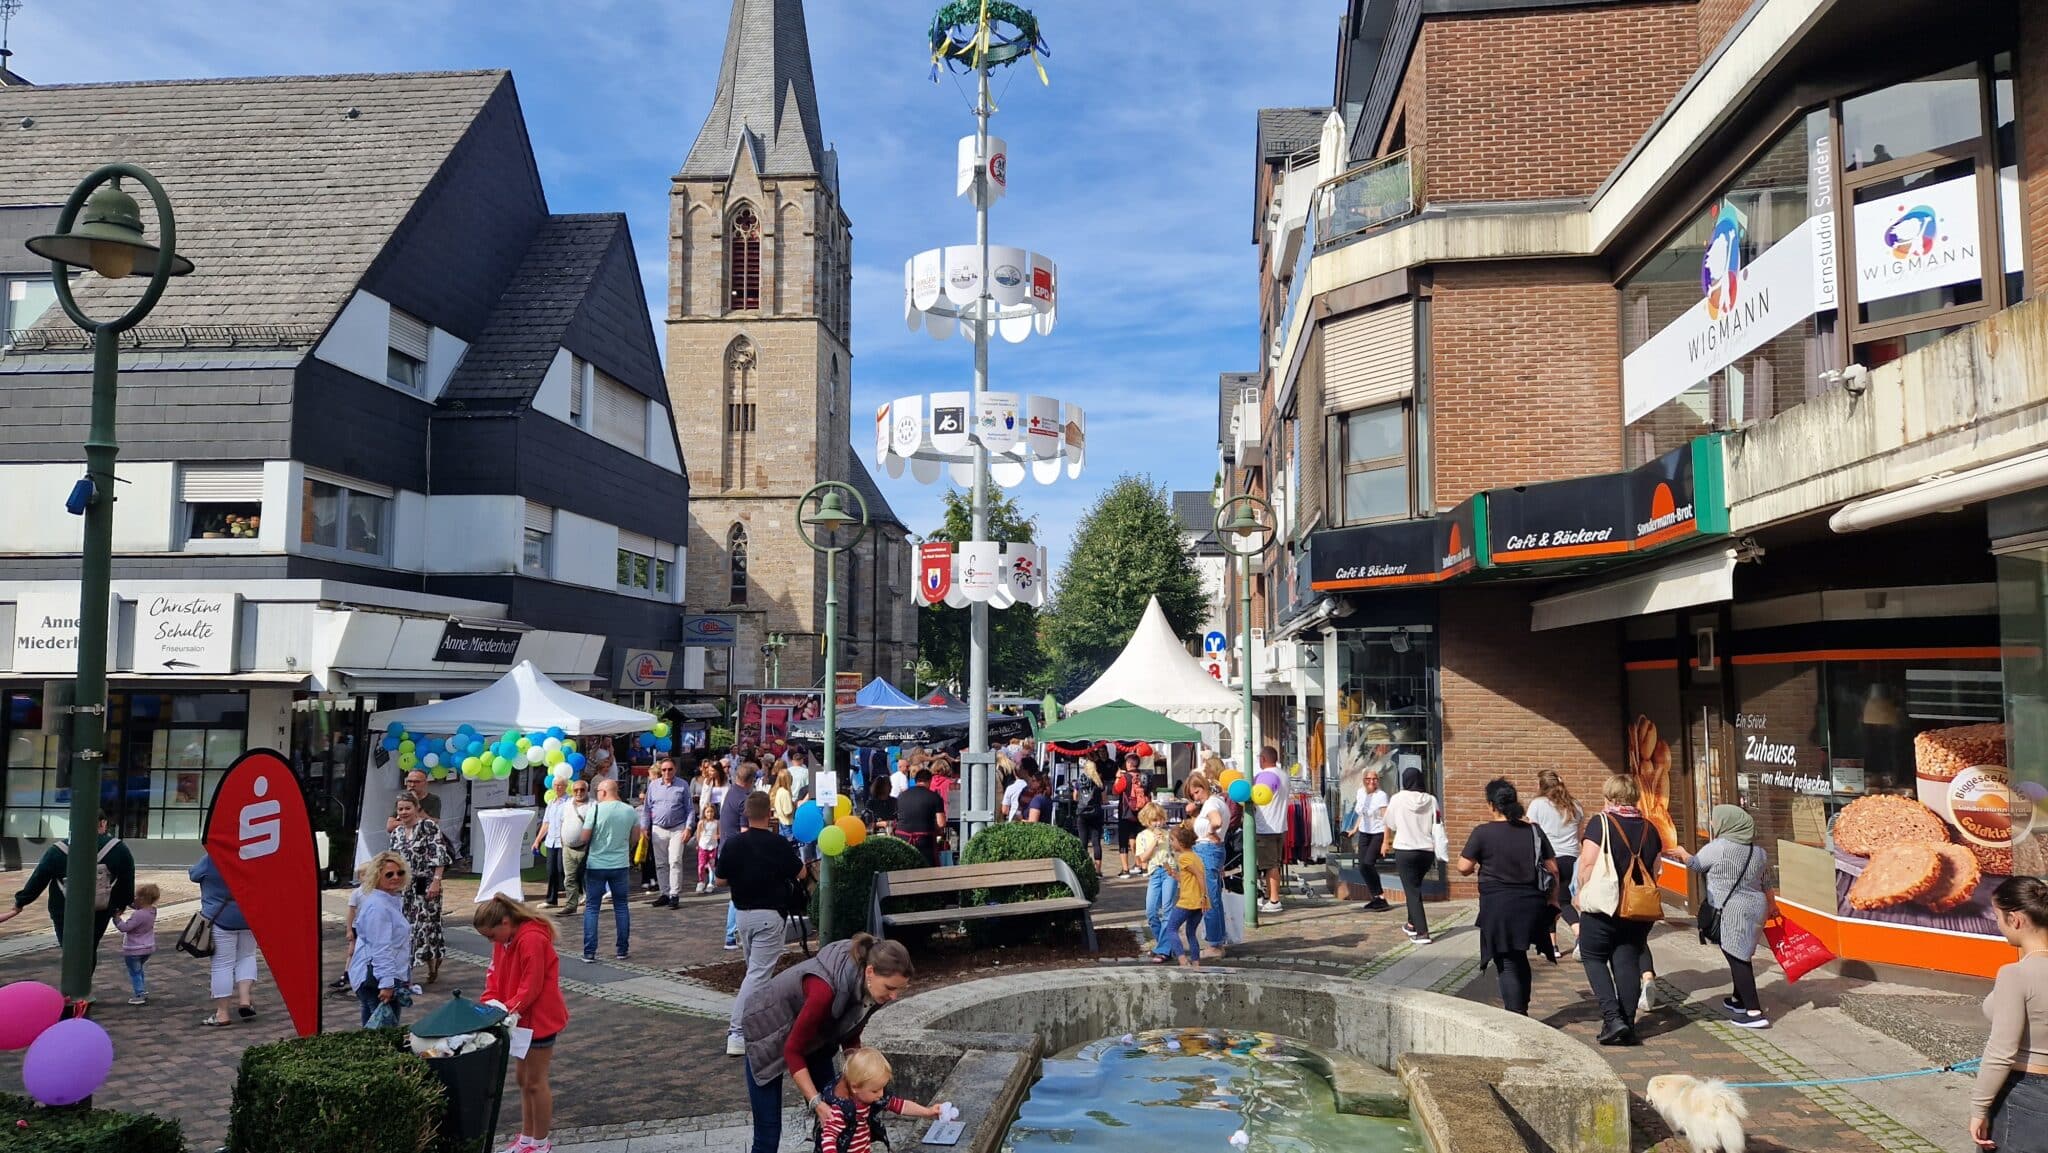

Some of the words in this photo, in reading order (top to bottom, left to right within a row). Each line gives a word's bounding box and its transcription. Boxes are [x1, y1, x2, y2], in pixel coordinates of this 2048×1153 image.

[1814, 135, 1831, 207] Sundern
[1820, 211, 1835, 306] Lernstudio
[1863, 244, 1974, 281] WIGMANN
[1035, 285, 1050, 299] SPD
[1688, 287, 1770, 363] WIGMANN
[1636, 503, 1693, 537] Sondermann-Brot
[1506, 532, 1537, 550] Café
[1538, 532, 1549, 547] &
[1551, 527, 1613, 546] Bäckerei
[1335, 566, 1358, 579] Café
[1358, 566, 1366, 577] &
[1367, 563, 1408, 577] Bäckerei
[149, 597, 222, 617] Christina
[41, 615, 81, 629] Anne
[154, 620, 214, 641] Schulte
[441, 635, 468, 650] Anne
[468, 636, 519, 654] Miederhoff
[1744, 735, 1797, 767] Zuhause,
[1761, 772, 1773, 785] von
[1774, 770, 1794, 788] Hand
[1794, 773, 1832, 793] gebacken.
